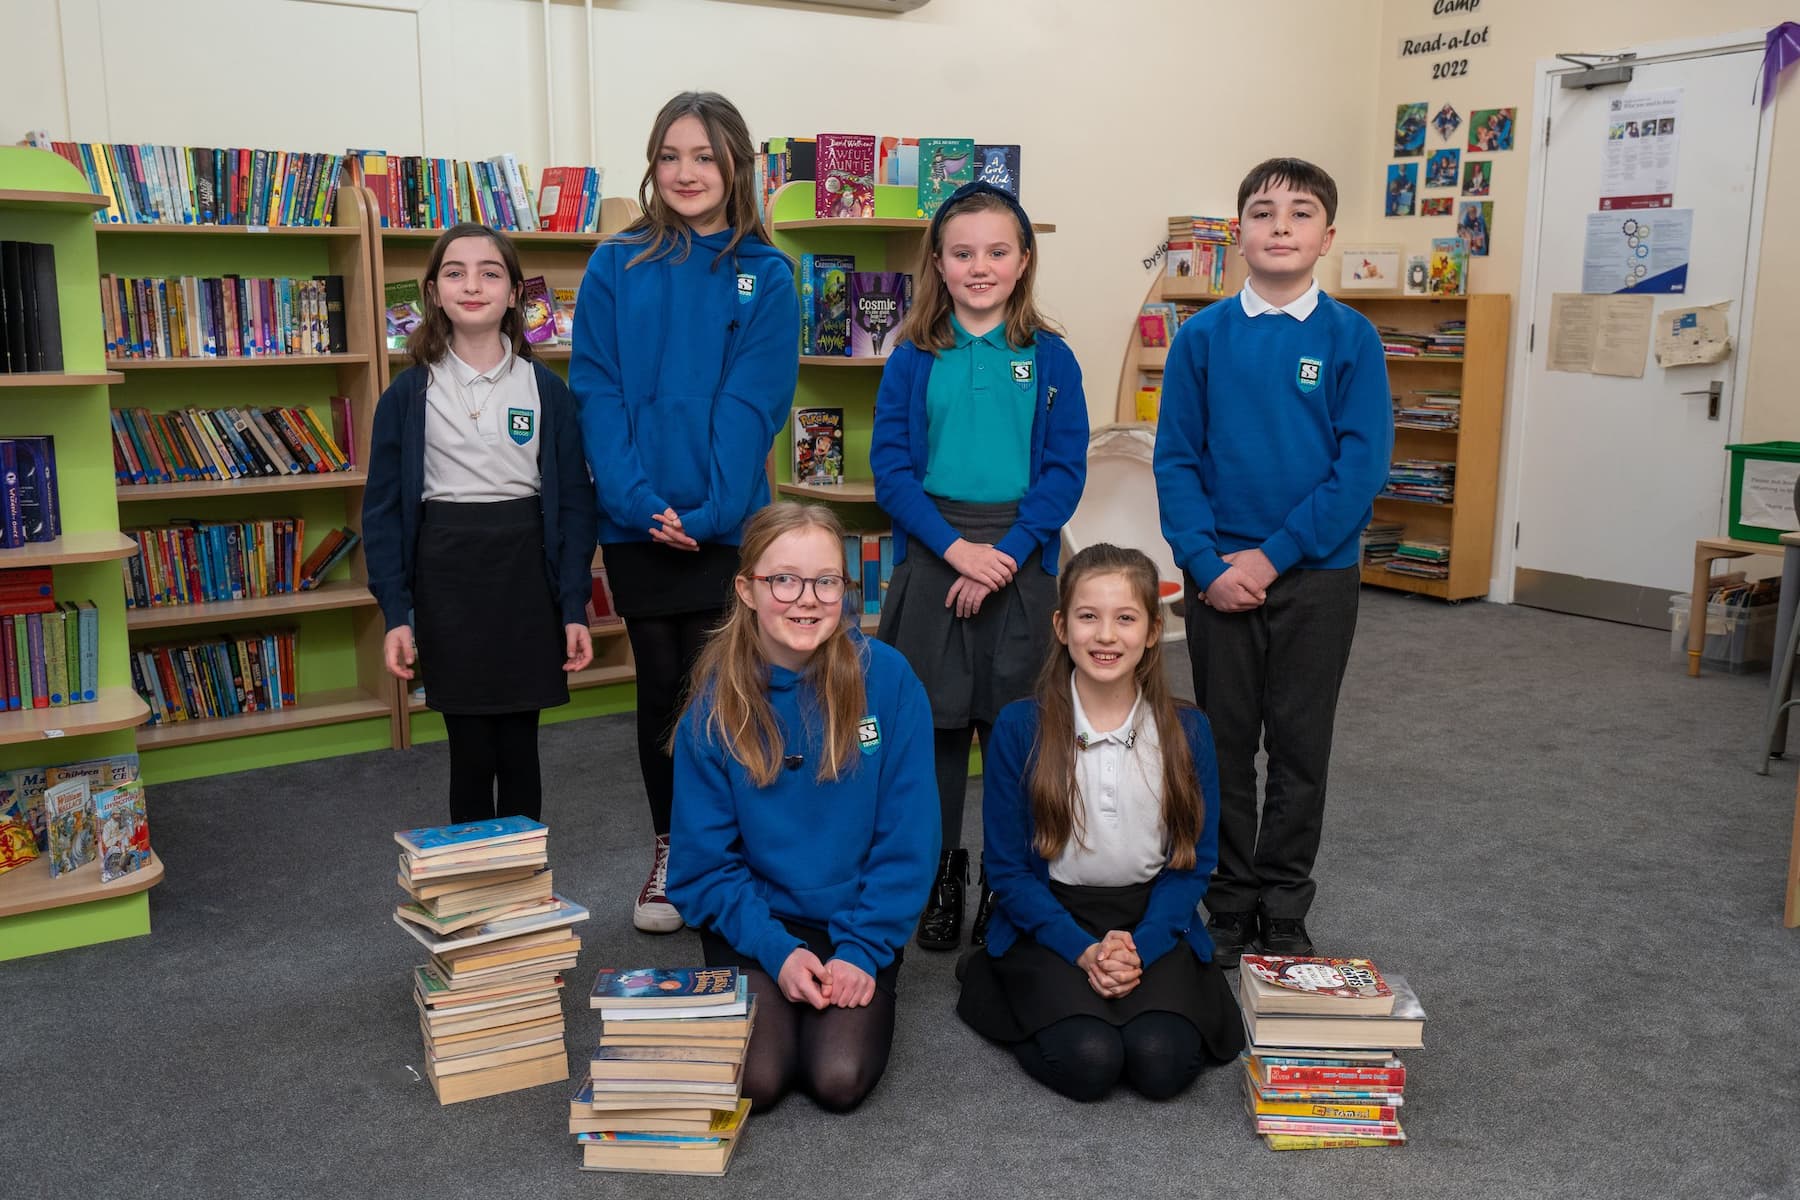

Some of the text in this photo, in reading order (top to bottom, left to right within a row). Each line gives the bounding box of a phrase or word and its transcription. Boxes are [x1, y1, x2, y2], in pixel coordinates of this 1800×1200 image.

[1433, 0, 1481, 15] Camp
[1402, 25, 1489, 57] Read-a-Lot
[1432, 59, 1468, 80] 2022
[827, 147, 871, 161] AWFUL
[828, 158, 872, 172] AUNTIE
[1143, 240, 1168, 270] Dysle
[859, 297, 897, 311] Cosmic
